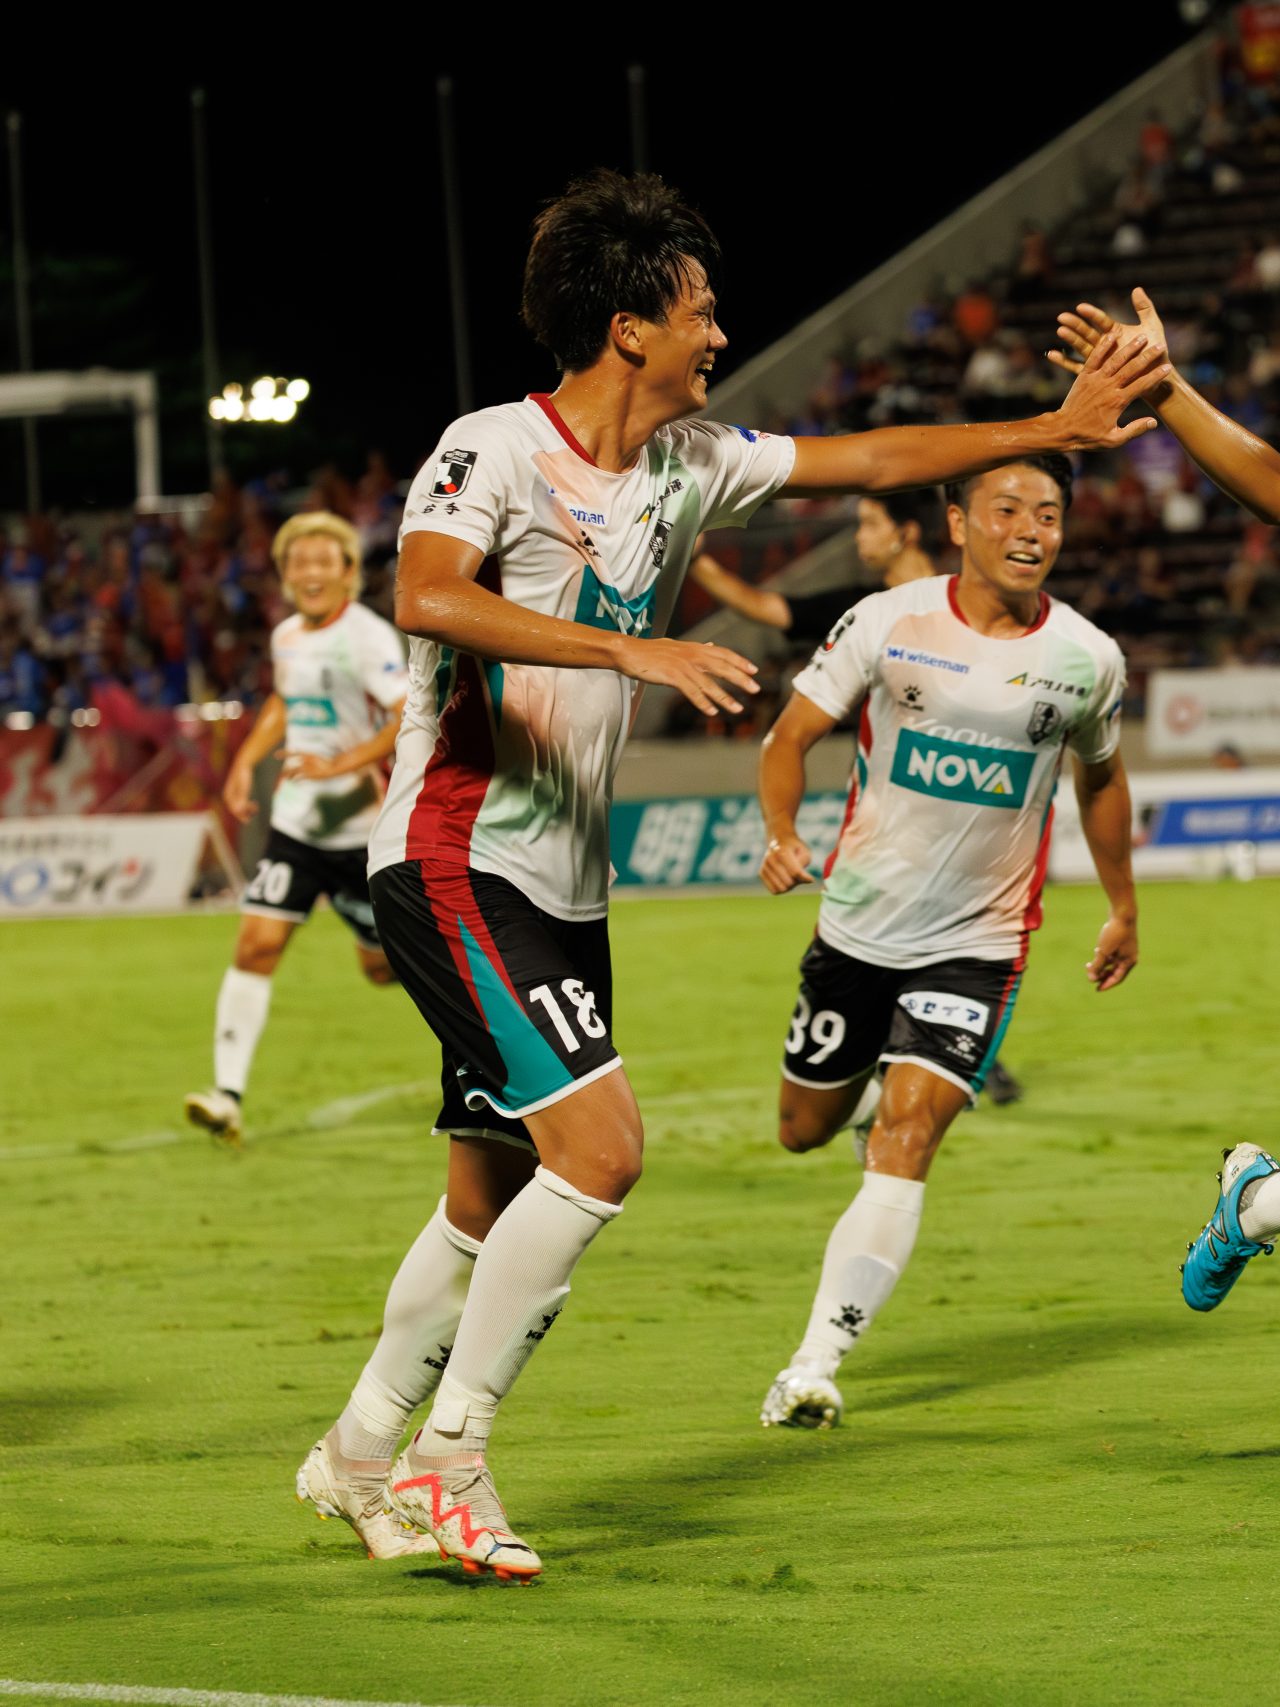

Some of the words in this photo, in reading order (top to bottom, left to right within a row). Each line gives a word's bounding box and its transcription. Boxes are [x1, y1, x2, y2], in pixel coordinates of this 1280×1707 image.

[907, 652, 969, 674] wiseman
[907, 746, 1014, 796] NOVA
[529, 978, 607, 1054] 18
[785, 995, 846, 1065] 39
